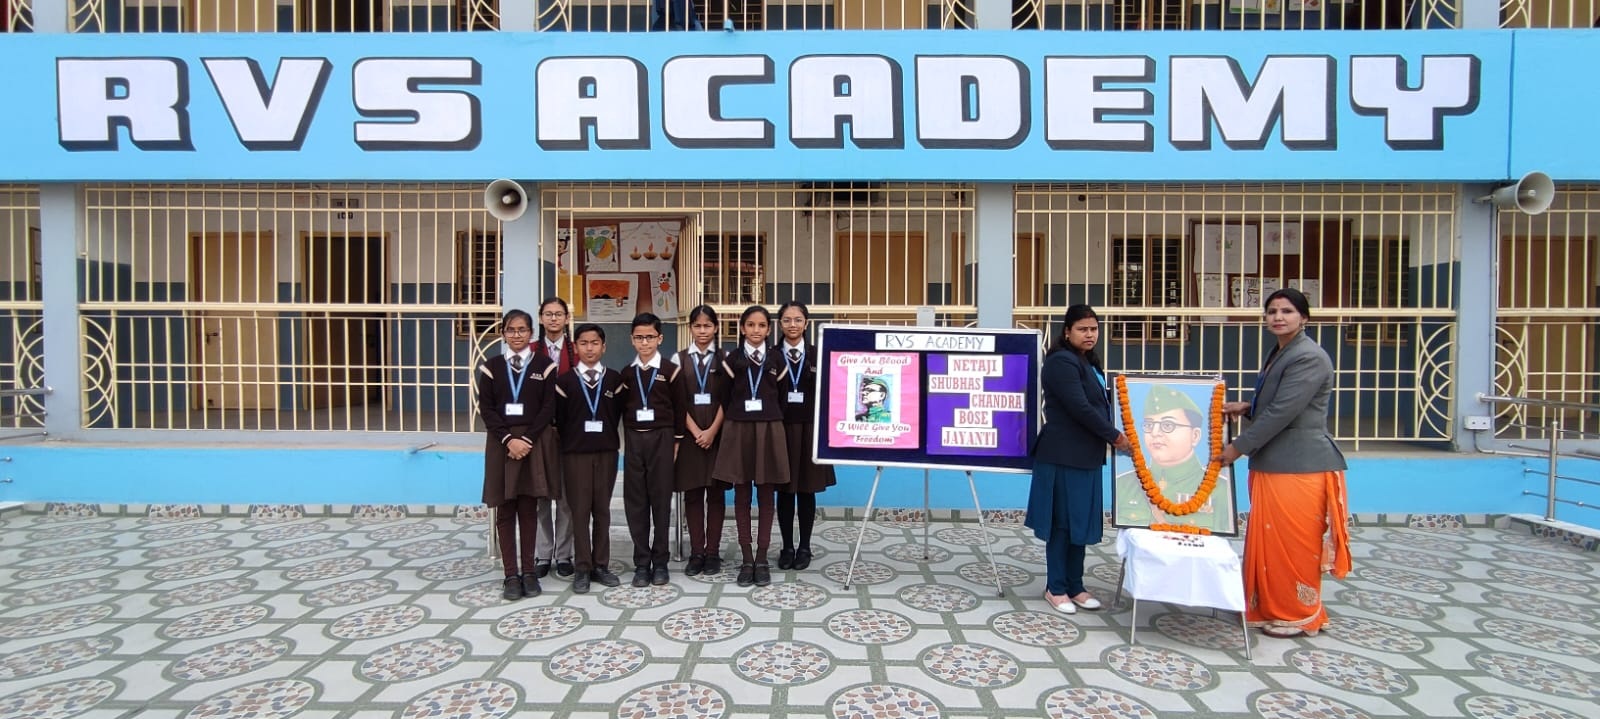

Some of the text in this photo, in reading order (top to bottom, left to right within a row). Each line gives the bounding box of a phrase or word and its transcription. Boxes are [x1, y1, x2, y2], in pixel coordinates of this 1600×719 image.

[55, 54, 1480, 152] RVS ACADEMY
[885, 334, 984, 350] RVS ACADEMY
[840, 355, 908, 365] Give Me Blood
[953, 359, 997, 375] NETAJI
[864, 367, 883, 375] And
[931, 376, 981, 391] SHUBHAS
[971, 394, 1023, 409] CHANDRA
[959, 411, 989, 425] BOSE
[848, 423, 868, 431] Will
[872, 424, 890, 432] Give
[891, 423, 910, 432] You
[856, 435, 893, 443] Freedom
[943, 430, 996, 446] JAYANTI
